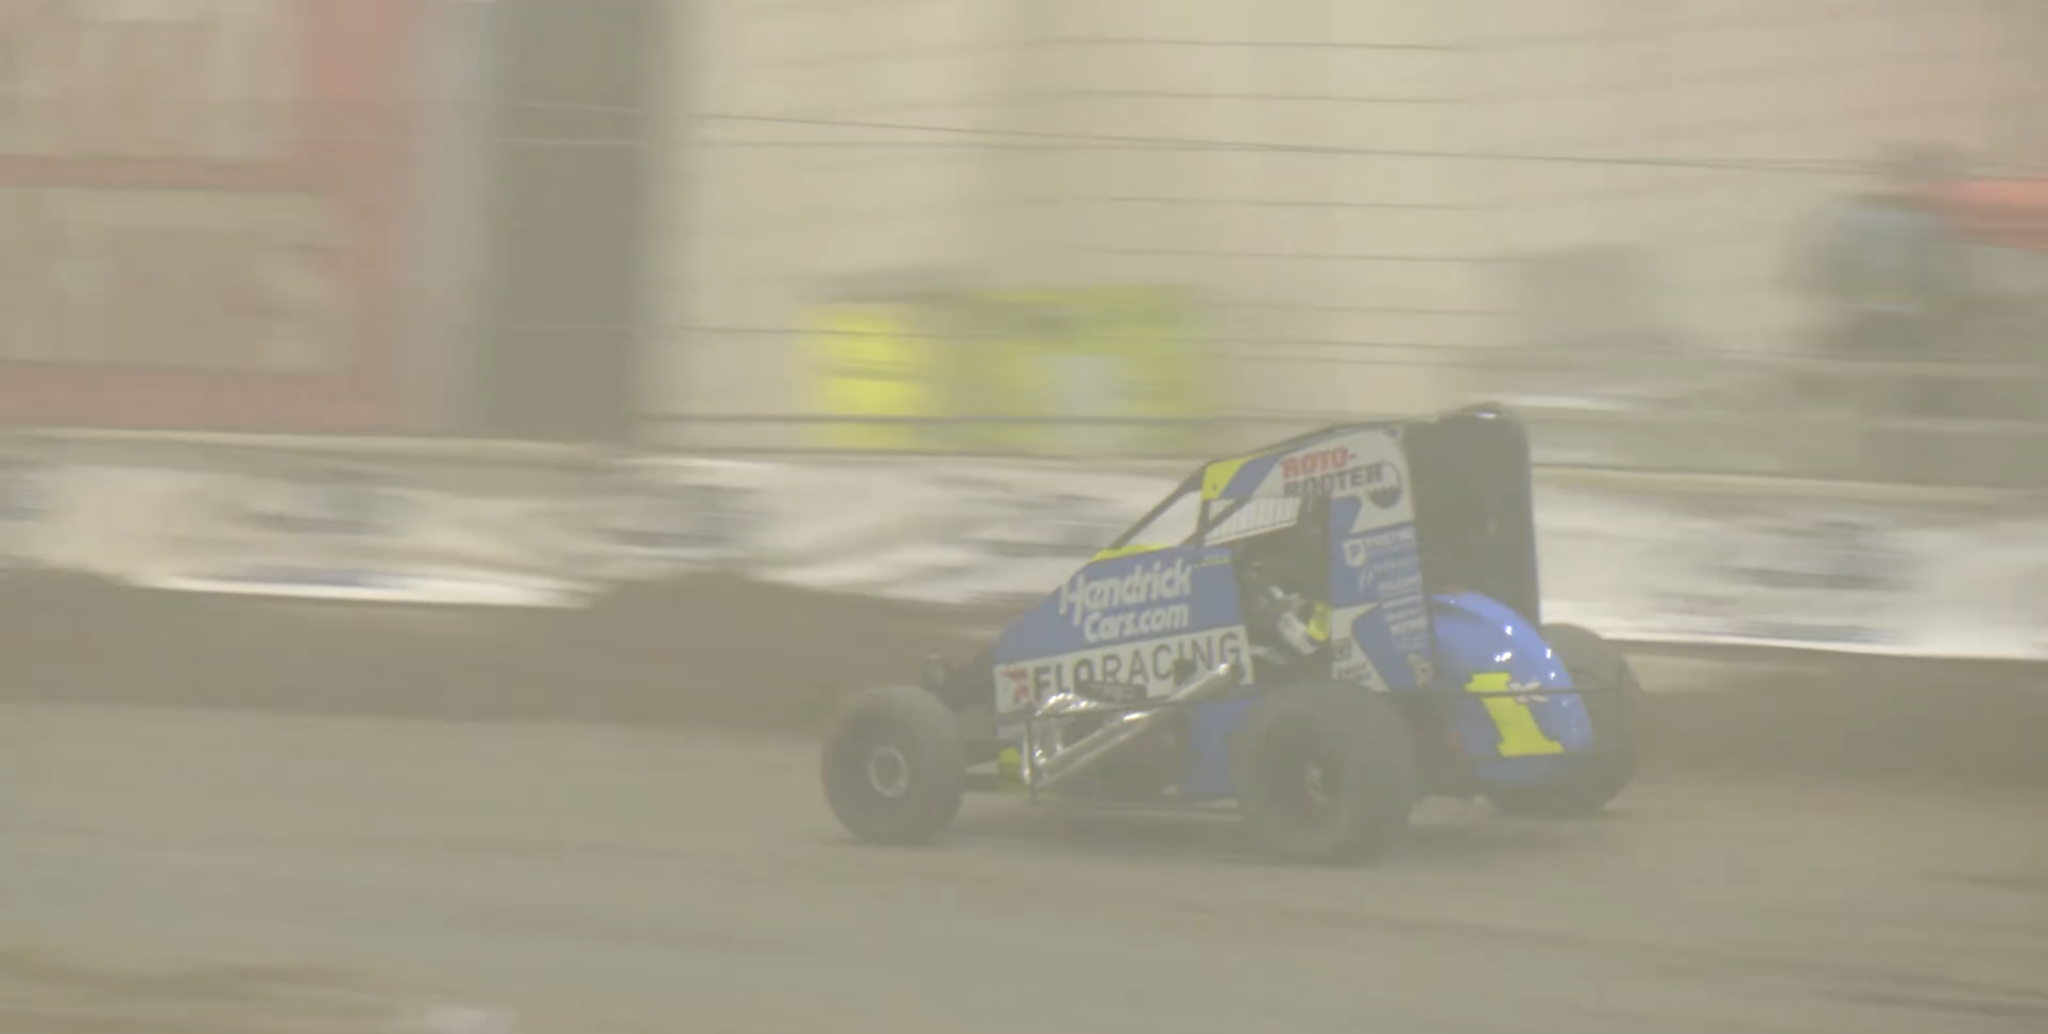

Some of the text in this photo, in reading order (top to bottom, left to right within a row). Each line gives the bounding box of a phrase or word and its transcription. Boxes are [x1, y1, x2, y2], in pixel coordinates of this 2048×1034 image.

[1282, 447, 1357, 479] ROTO-
[1059, 557, 1193, 626] Hendrick
[1084, 602, 1189, 643] Cars.com
